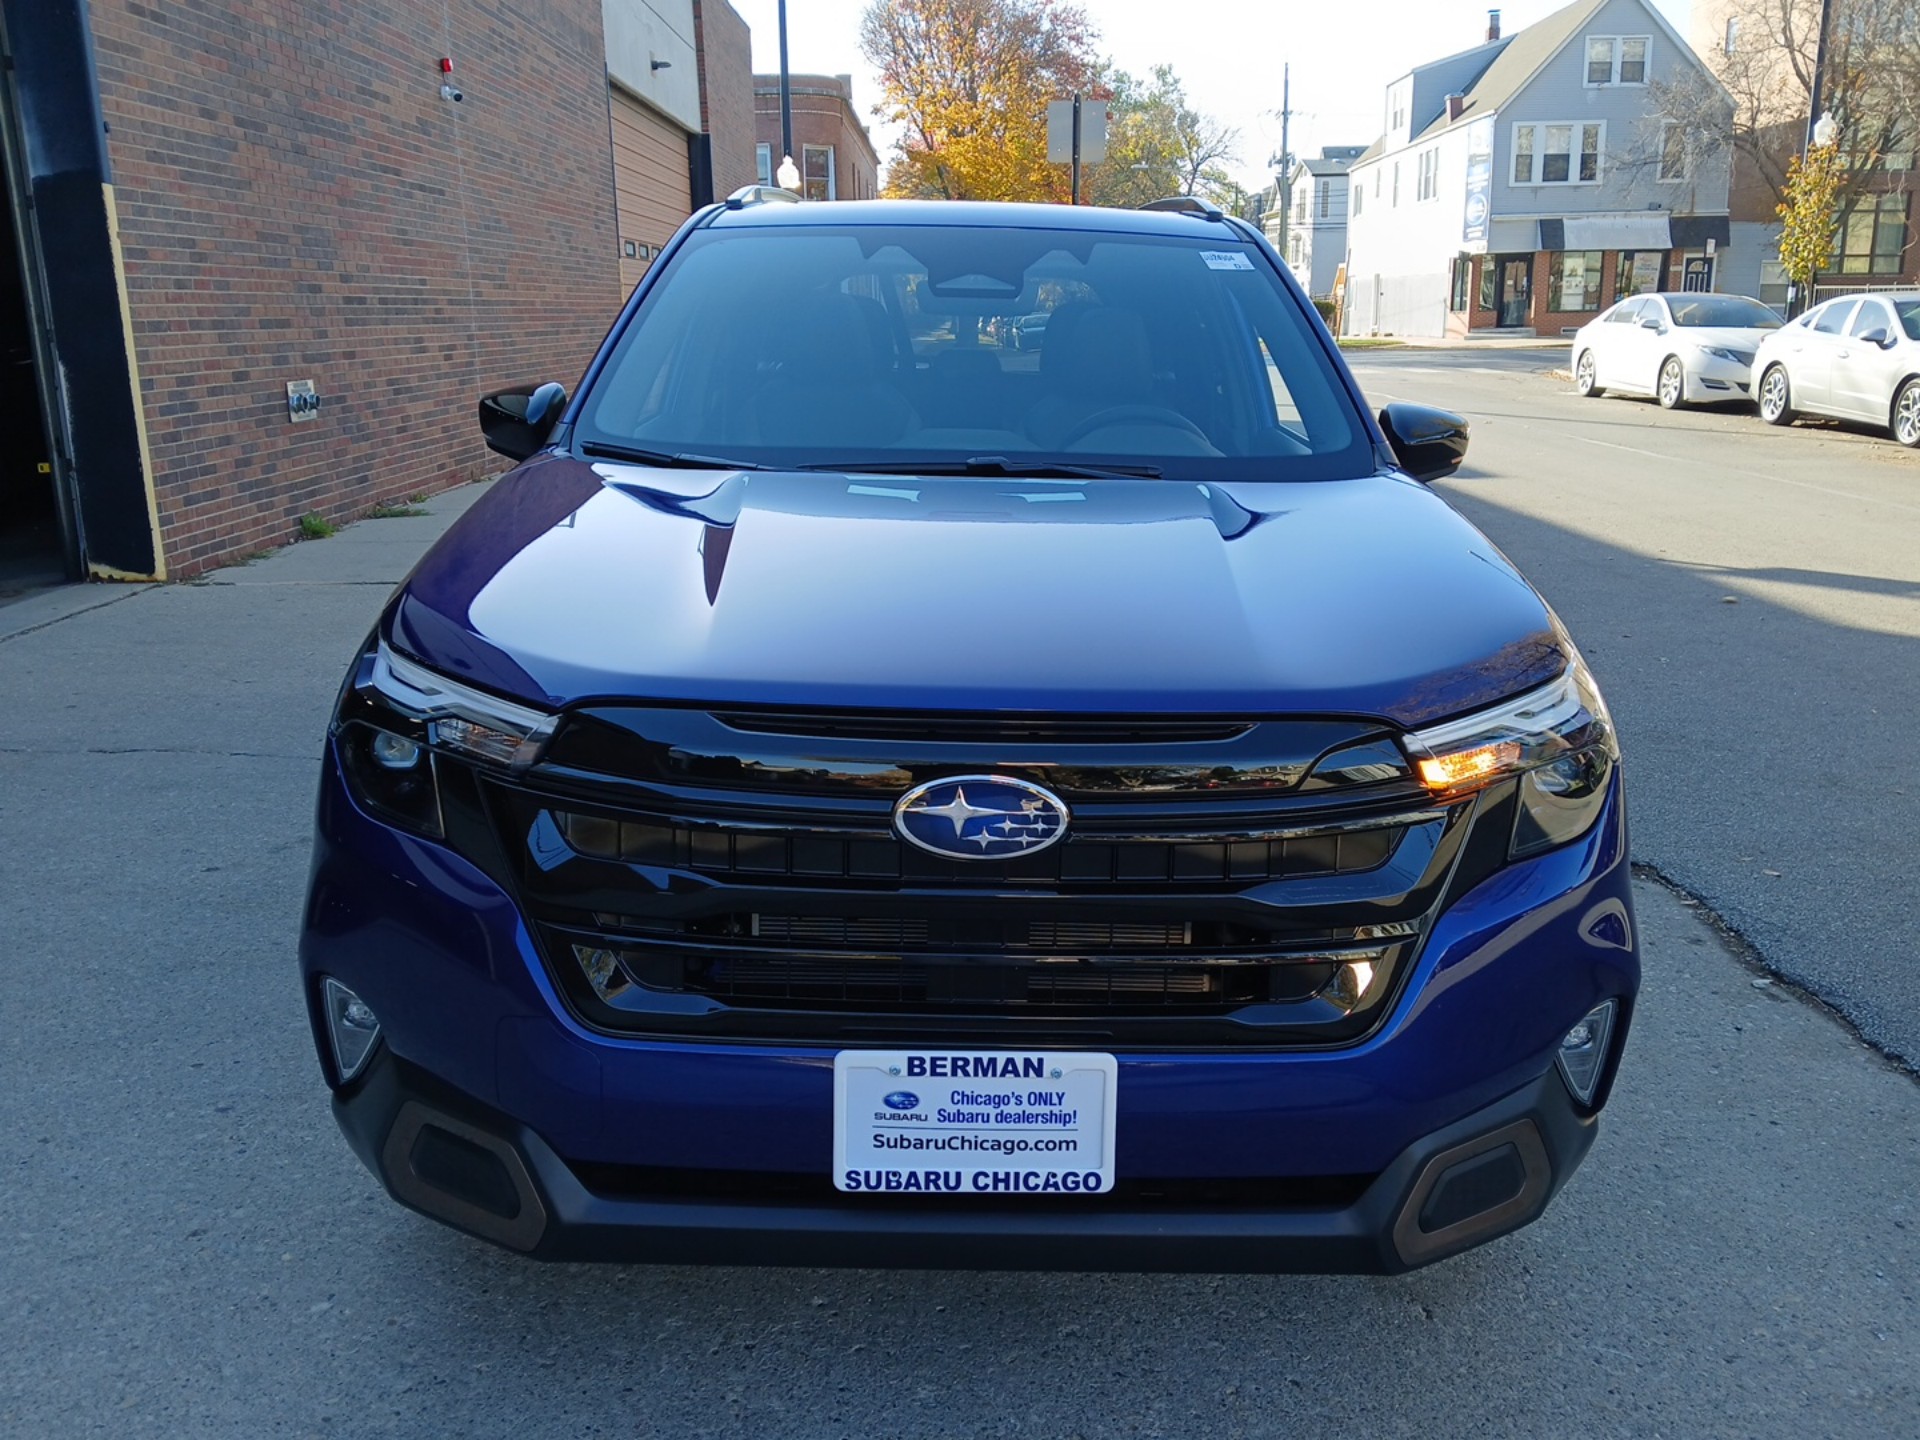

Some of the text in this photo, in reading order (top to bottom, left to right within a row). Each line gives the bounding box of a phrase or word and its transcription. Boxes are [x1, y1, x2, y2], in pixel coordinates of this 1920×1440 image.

[907, 1056, 1044, 1078] BERMAN
[951, 1090, 1066, 1108] Chicago's ONLY
[874, 1112, 928, 1122] SUBARU
[937, 1108, 1077, 1126] Subaru dealership!
[872, 1134, 1077, 1155] SubaruChicago.com
[845, 1170, 1102, 1192] SUBARU CHICAGO
